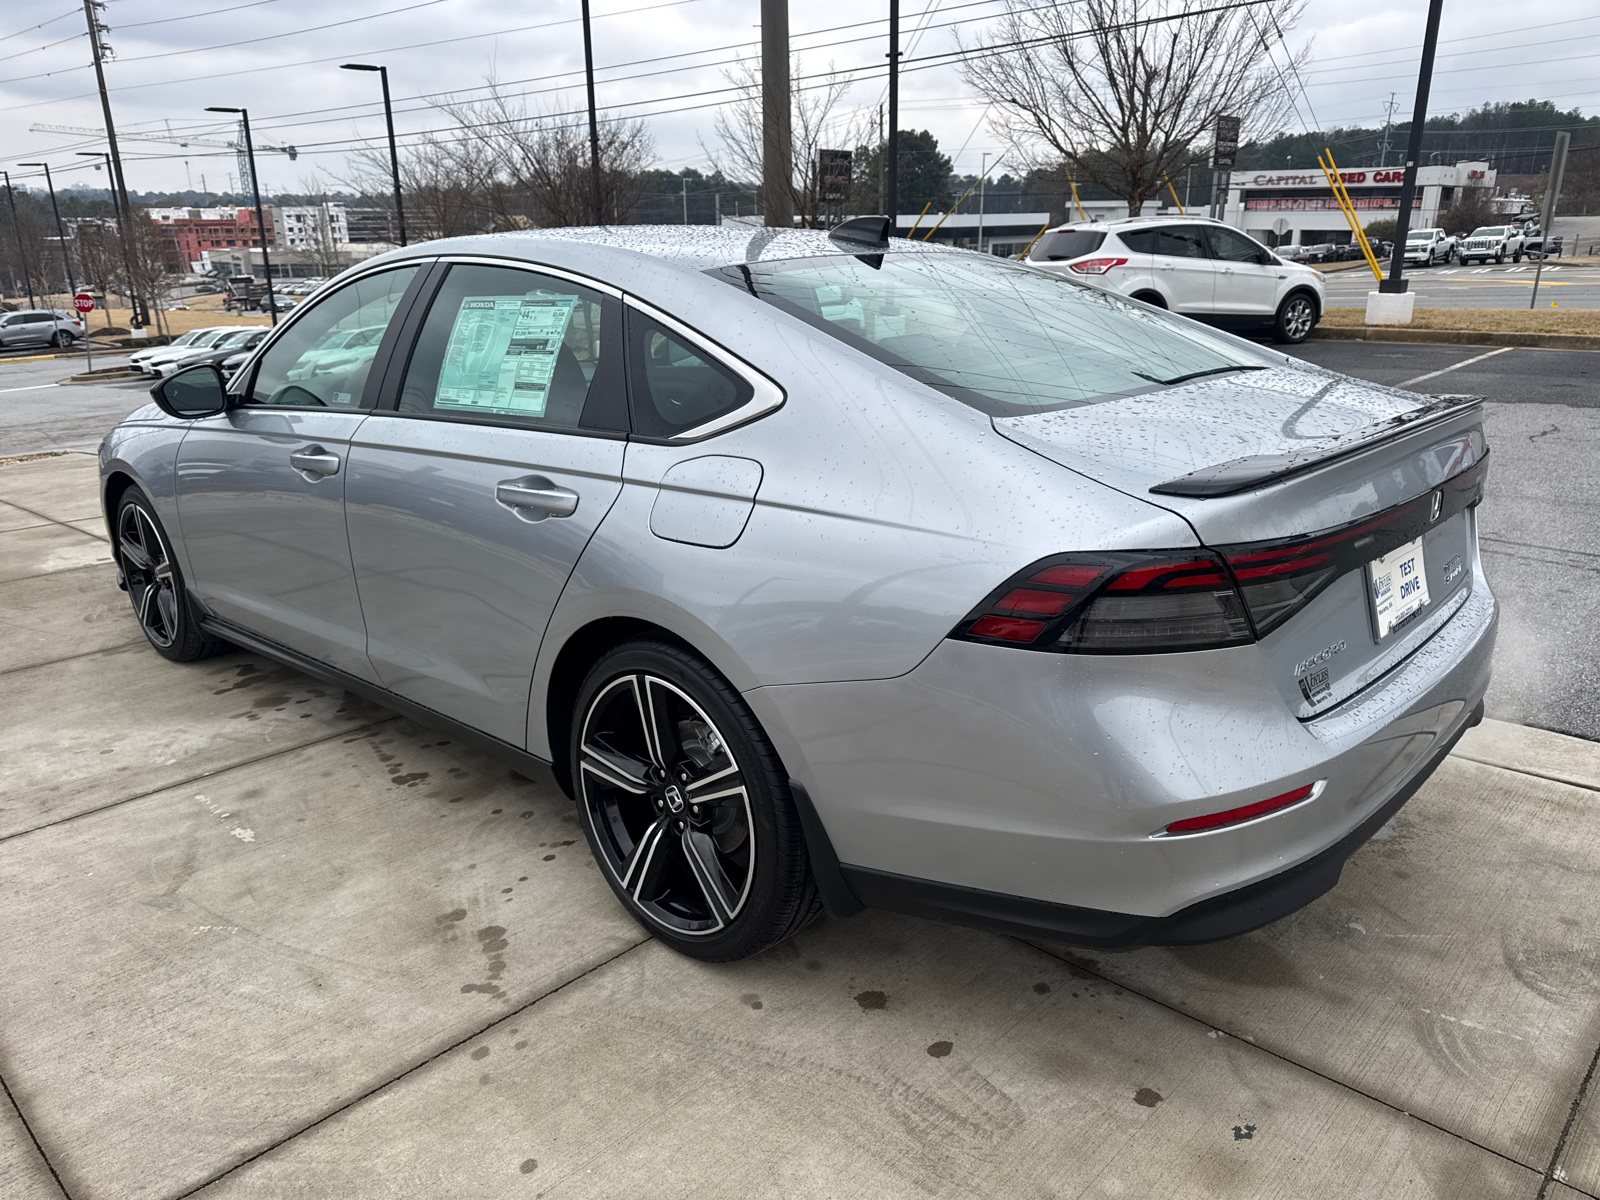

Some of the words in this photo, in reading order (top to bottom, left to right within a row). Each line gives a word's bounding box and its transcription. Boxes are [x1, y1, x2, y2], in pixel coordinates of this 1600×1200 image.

[1253, 174, 1317, 186] CAPITAL
[1329, 172, 1366, 184] USED
[74, 299, 94, 307] STOP
[1399, 557, 1415, 578] TEST
[1399, 576, 1421, 600] DRIVE
[1293, 639, 1347, 676] ACCORD
[1304, 670, 1329, 694] VOYLES
